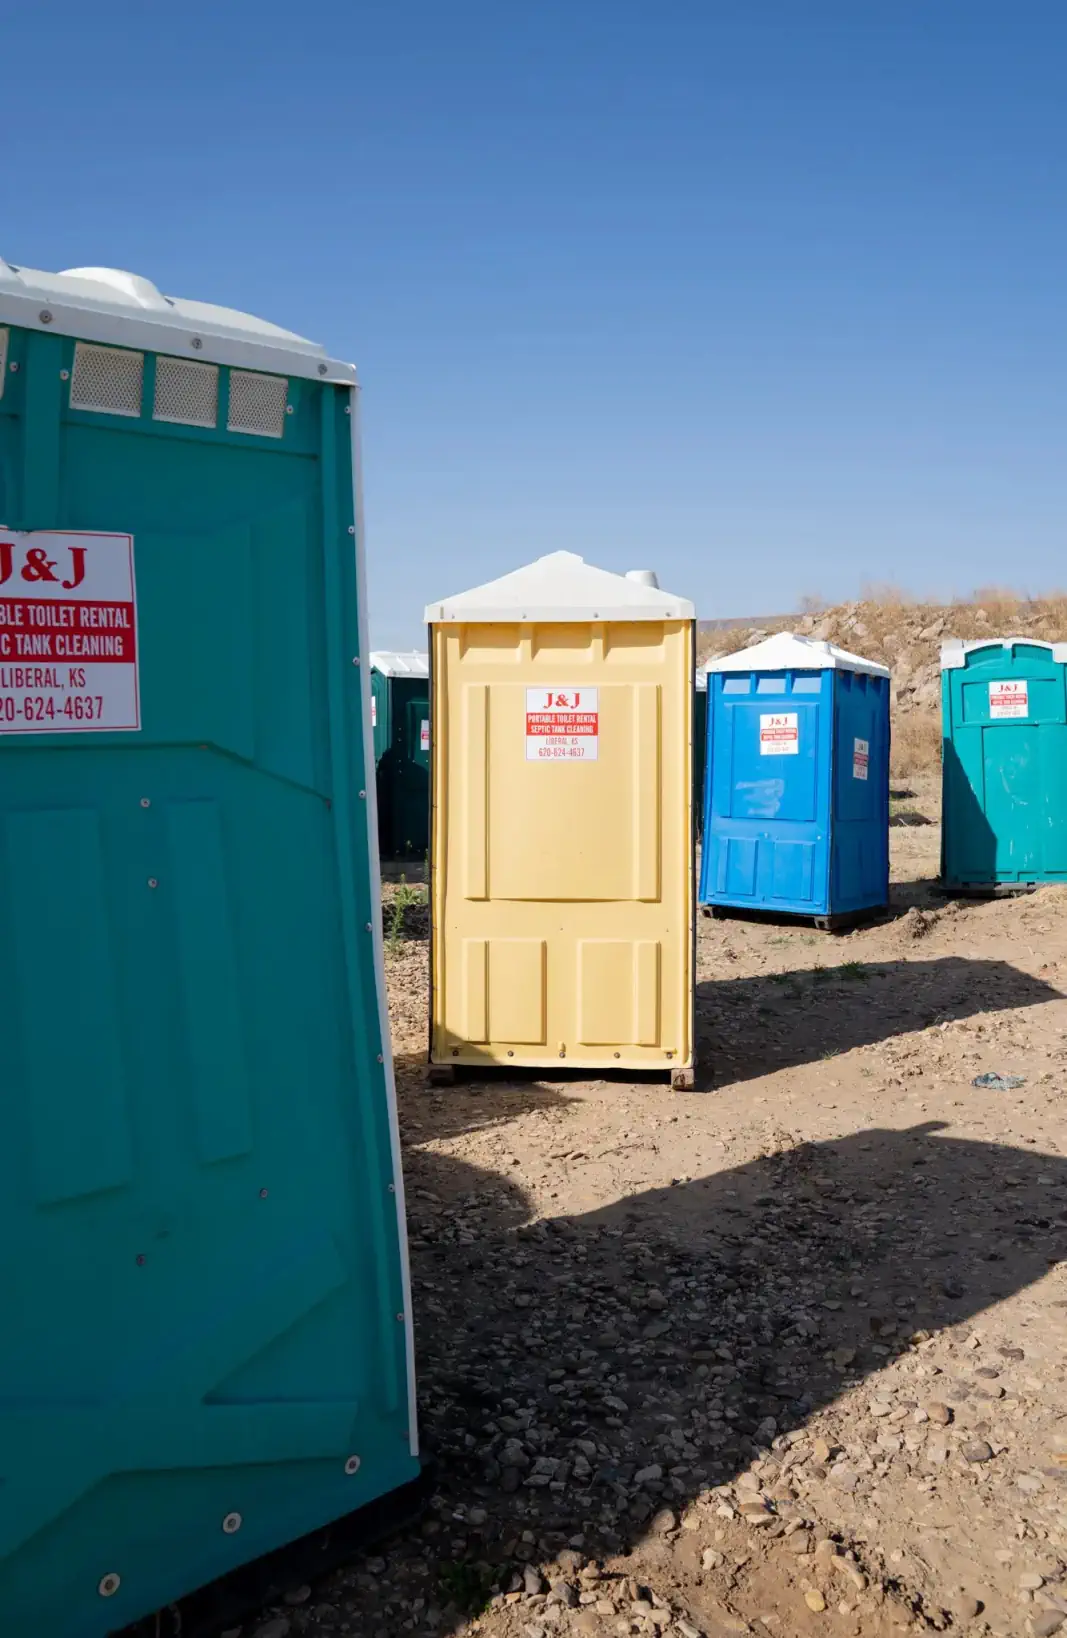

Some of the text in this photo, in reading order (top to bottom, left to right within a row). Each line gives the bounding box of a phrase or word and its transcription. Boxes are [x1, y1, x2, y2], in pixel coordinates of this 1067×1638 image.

[0, 543, 88, 589] J&J
[27, 605, 76, 627] TOILET
[80, 606, 131, 629] RENTAL
[15, 633, 52, 656] TANK
[55, 634, 124, 656] CLEANING
[1, 667, 86, 691] LIBERAL, KS
[543, 692, 580, 709] J&J
[528, 714, 597, 723] PORTABLE TOILET RENTAL
[531, 725, 593, 733] SEPTIC TANK CLEANING
[538, 747, 585, 757] 620-624-4637
